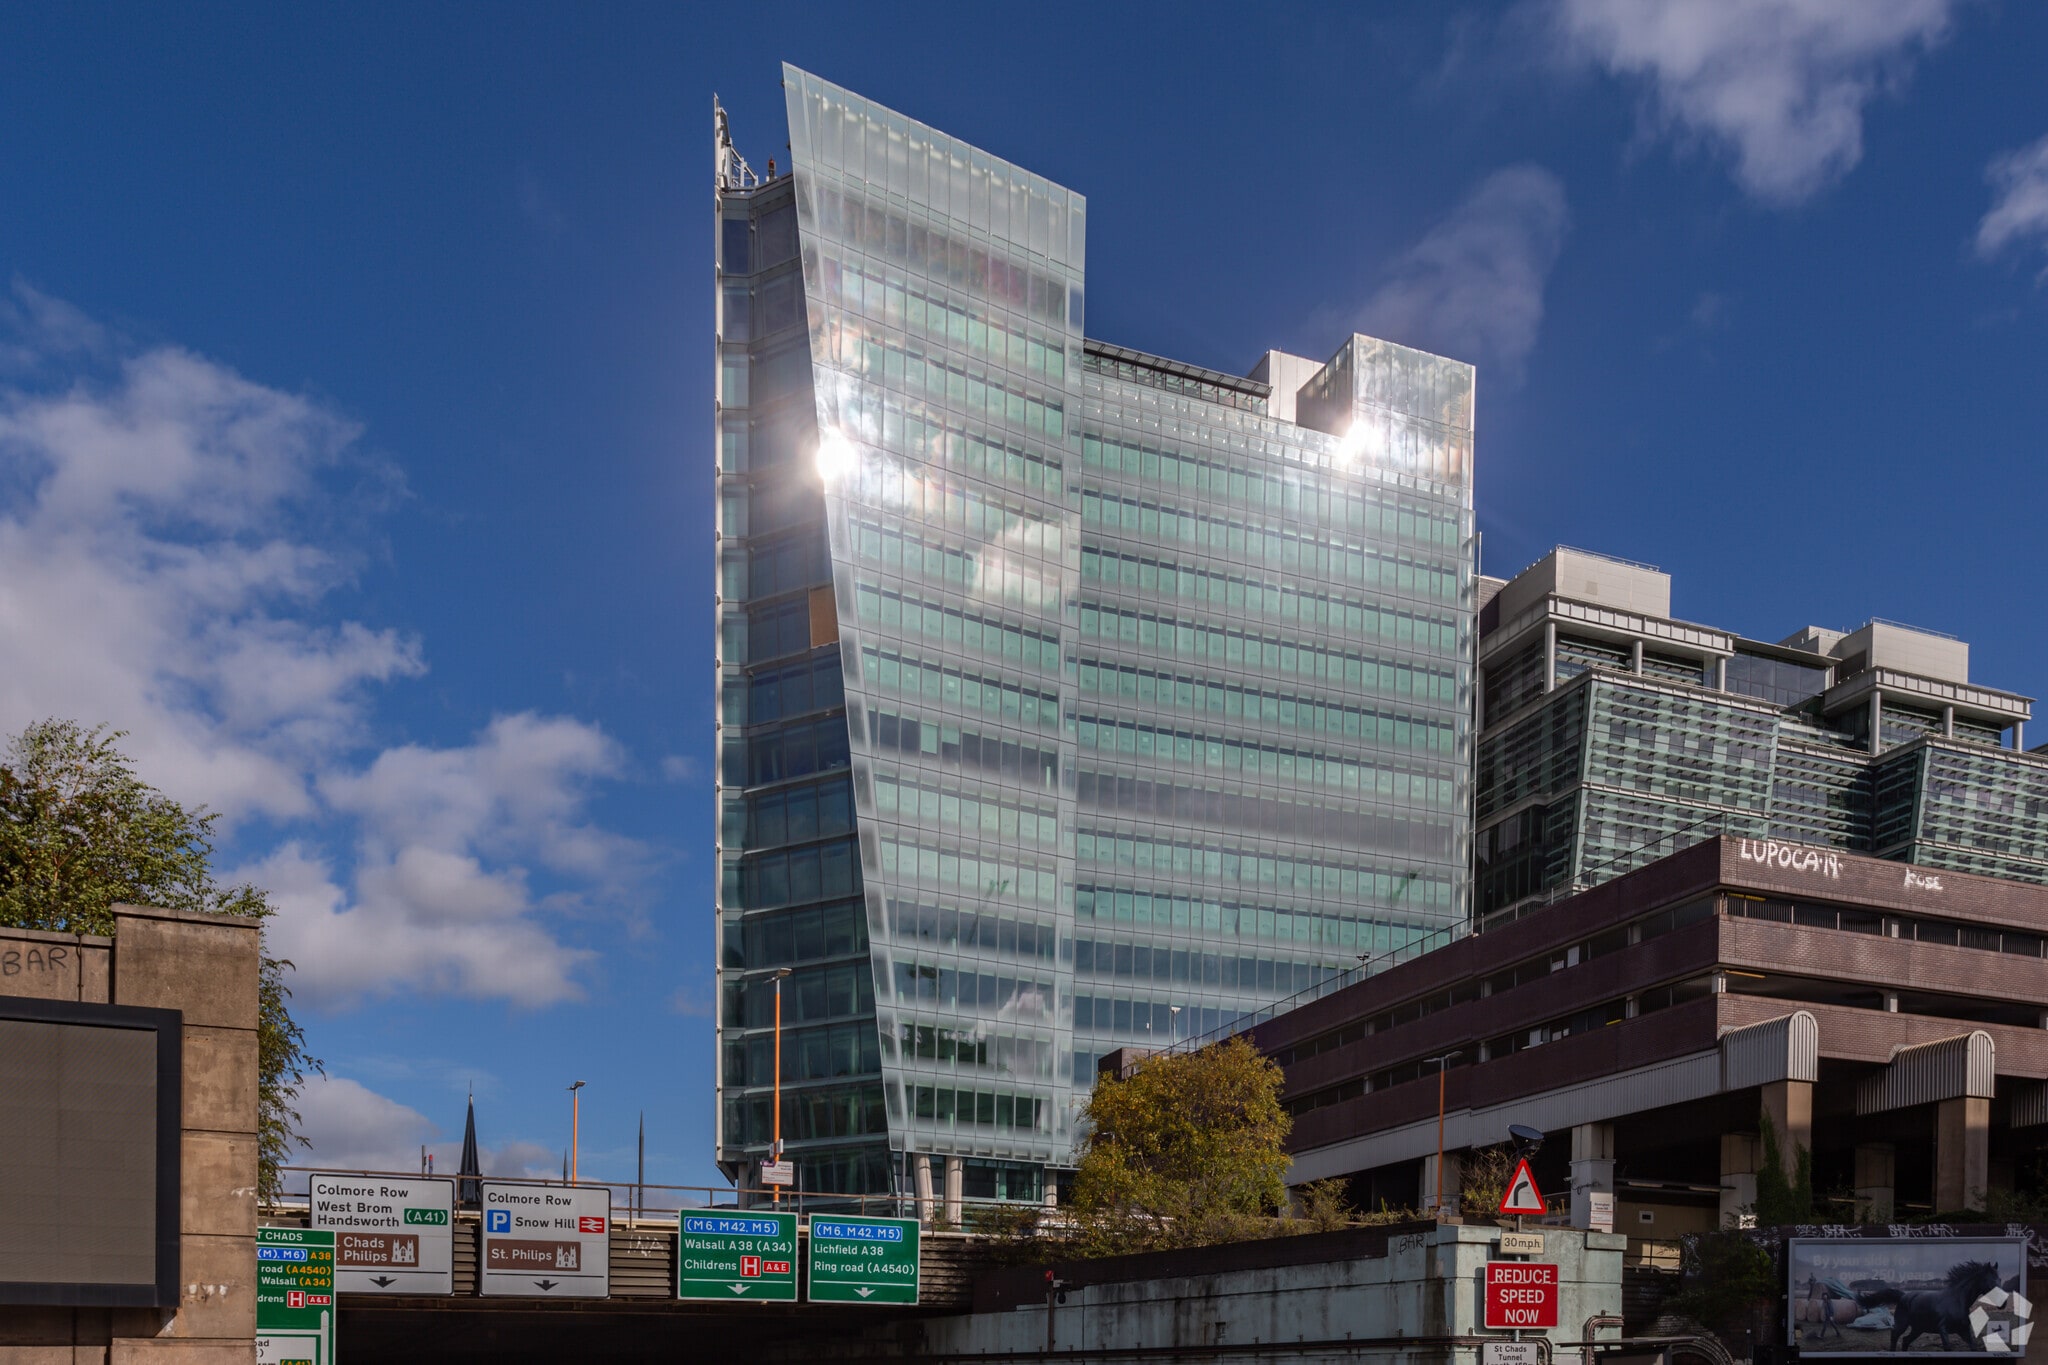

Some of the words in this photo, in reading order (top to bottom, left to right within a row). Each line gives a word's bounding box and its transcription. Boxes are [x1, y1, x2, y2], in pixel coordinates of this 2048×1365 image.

[2, 946, 68, 976] BAR
[317, 1184, 375, 1197] Colmore
[380, 1186, 409, 1198] Row
[488, 1192, 541, 1205] Colmore
[545, 1195, 572, 1206] Row
[317, 1201, 352, 1213] West
[357, 1202, 392, 1214] Brom
[317, 1214, 400, 1227] Handsworth
[515, 1217, 549, 1228] Snow
[554, 1218, 575, 1229] Hill
[265, 1231, 303, 1241] CHADS
[343, 1236, 385, 1248] Chads
[685, 1239, 725, 1250] Walsall
[814, 1243, 858, 1255] Lichfield
[1397, 1234, 1424, 1256] BAR
[344, 1249, 388, 1263] Philips
[491, 1248, 509, 1259] St.
[512, 1249, 552, 1262] Philips
[1813, 1254, 1830, 1269] By
[1832, 1257, 1860, 1269] your
[1863, 1254, 1890, 1266] side
[261, 1265, 283, 1273] road
[684, 1259, 737, 1271] Childrens
[814, 1261, 837, 1273] Ring
[841, 1263, 864, 1273] road
[261, 1276, 297, 1286] Walsall
[1495, 1268, 1551, 1284] REDUCE
[1839, 1271, 1867, 1281] over
[1871, 1268, 1895, 1280] 250
[1898, 1271, 1935, 1283] years
[257, 1294, 285, 1303] drens
[1500, 1288, 1545, 1304] SPEED
[1505, 1308, 1539, 1324] NOW
[1494, 1345, 1503, 1353] St
[1505, 1345, 1527, 1353] Chads
[1498, 1353, 1523, 1361] Tunnel
